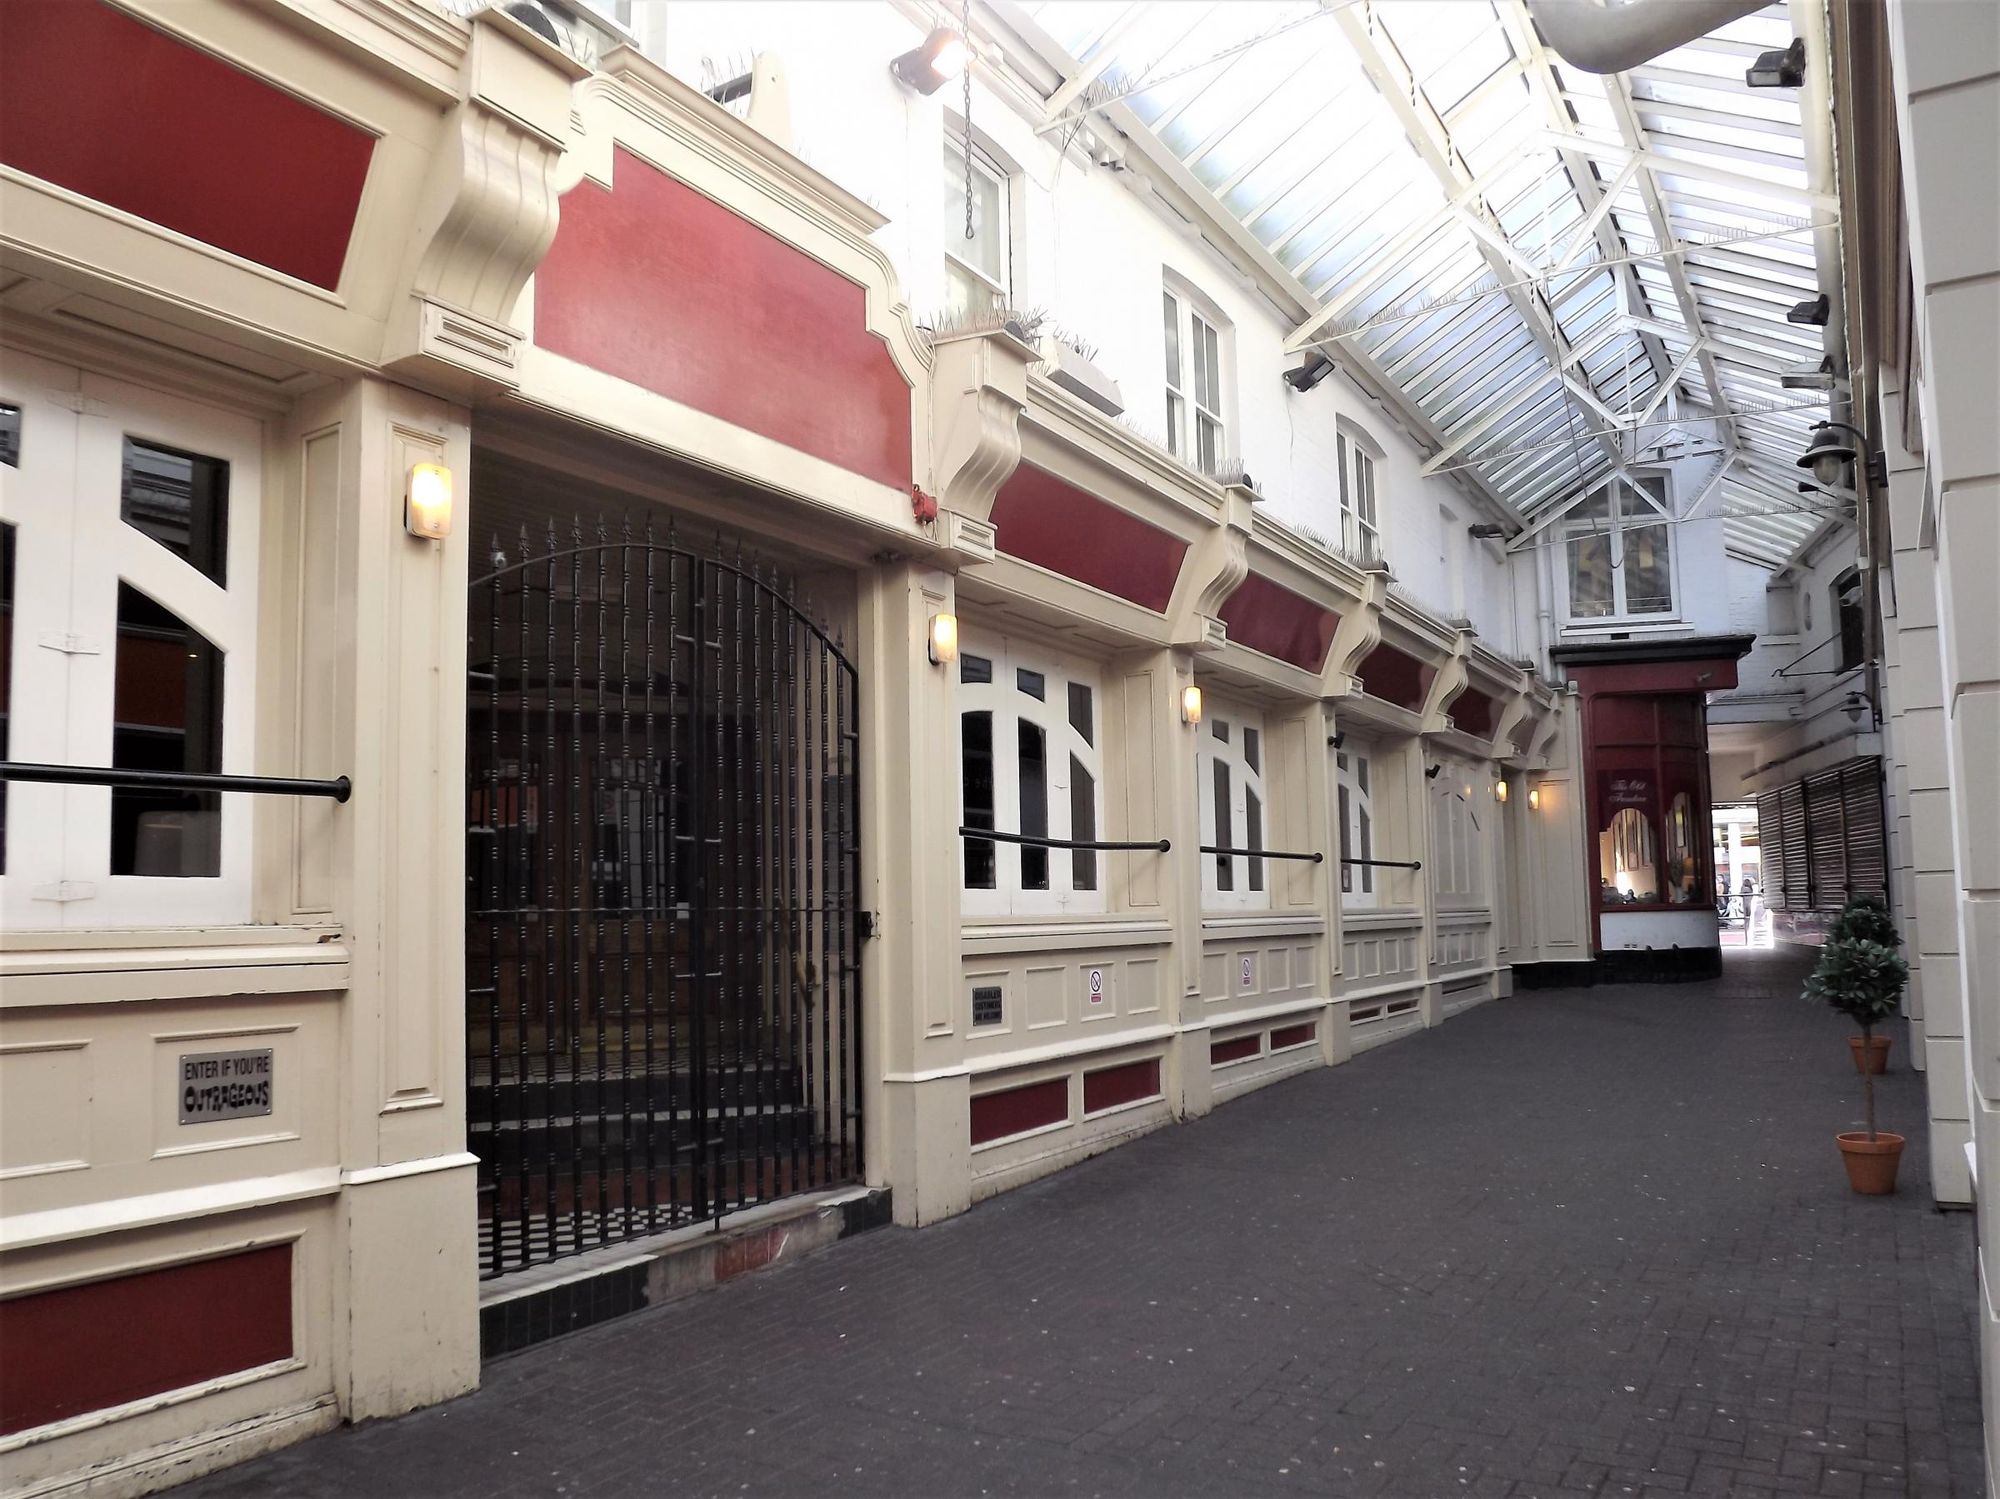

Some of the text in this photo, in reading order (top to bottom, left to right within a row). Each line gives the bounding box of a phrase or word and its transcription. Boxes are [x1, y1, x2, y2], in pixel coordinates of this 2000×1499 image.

[185, 1056, 270, 1080] ENTER IF YOU'RE
[184, 1080, 269, 1112] OUTRAGEOUS
